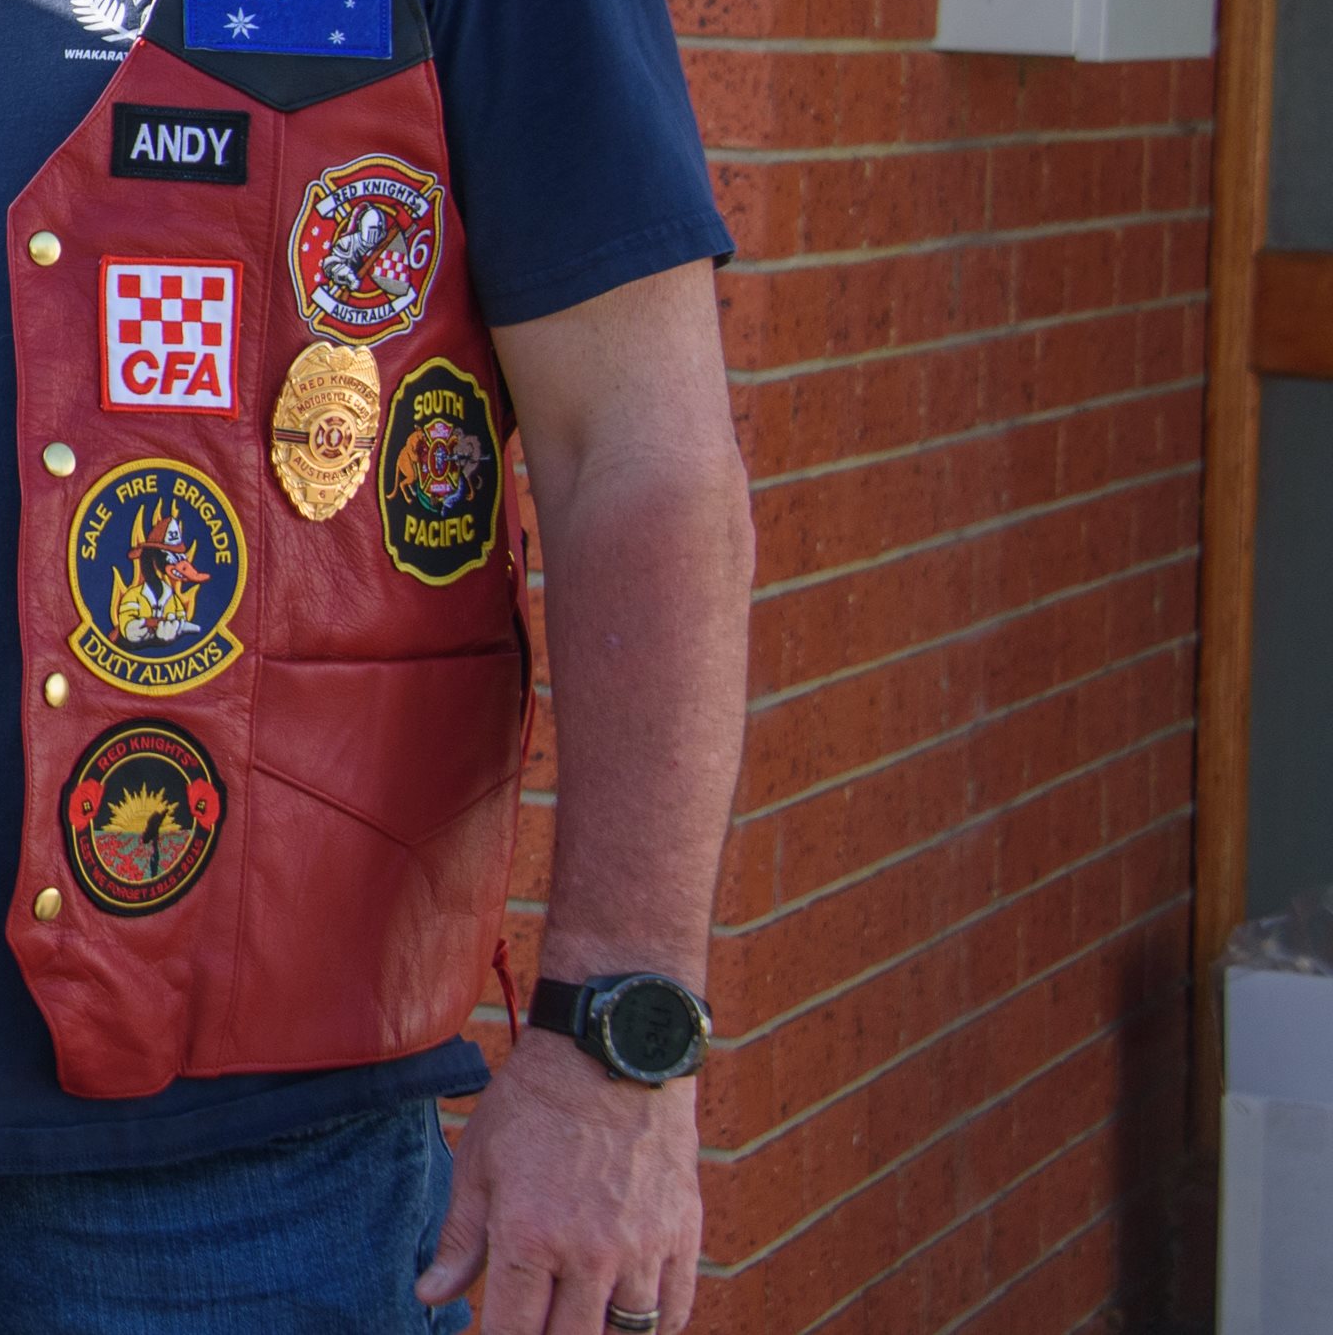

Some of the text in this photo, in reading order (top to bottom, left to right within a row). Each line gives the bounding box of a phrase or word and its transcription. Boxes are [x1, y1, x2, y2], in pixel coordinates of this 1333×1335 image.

[130, 123, 232, 165] ANDY
[333, 181, 420, 205] RED KNIGHTS
[410, 229, 431, 269] 6
[332, 303, 396, 323] AUSTRALIA
[121, 351, 223, 398] CFA
[298, 375, 378, 404] RED KNIGHTS
[296, 391, 371, 422] MOTORCYCLE CLUB
[413, 389, 464, 420] SOUTH
[293, 456, 360, 481] AUSTRALIA
[319, 489, 326, 499] 6
[81, 474, 232, 564] SALE FIRE BRIGADE
[404, 514, 475, 547] PACIFIC
[83, 633, 223, 684] DUTY ALWAYS
[97, 735, 192, 772] RED KNIGHTS
[80, 835, 96, 868] LEST
[92, 866, 105, 887] WE
[106, 878, 148, 900] FORGET
